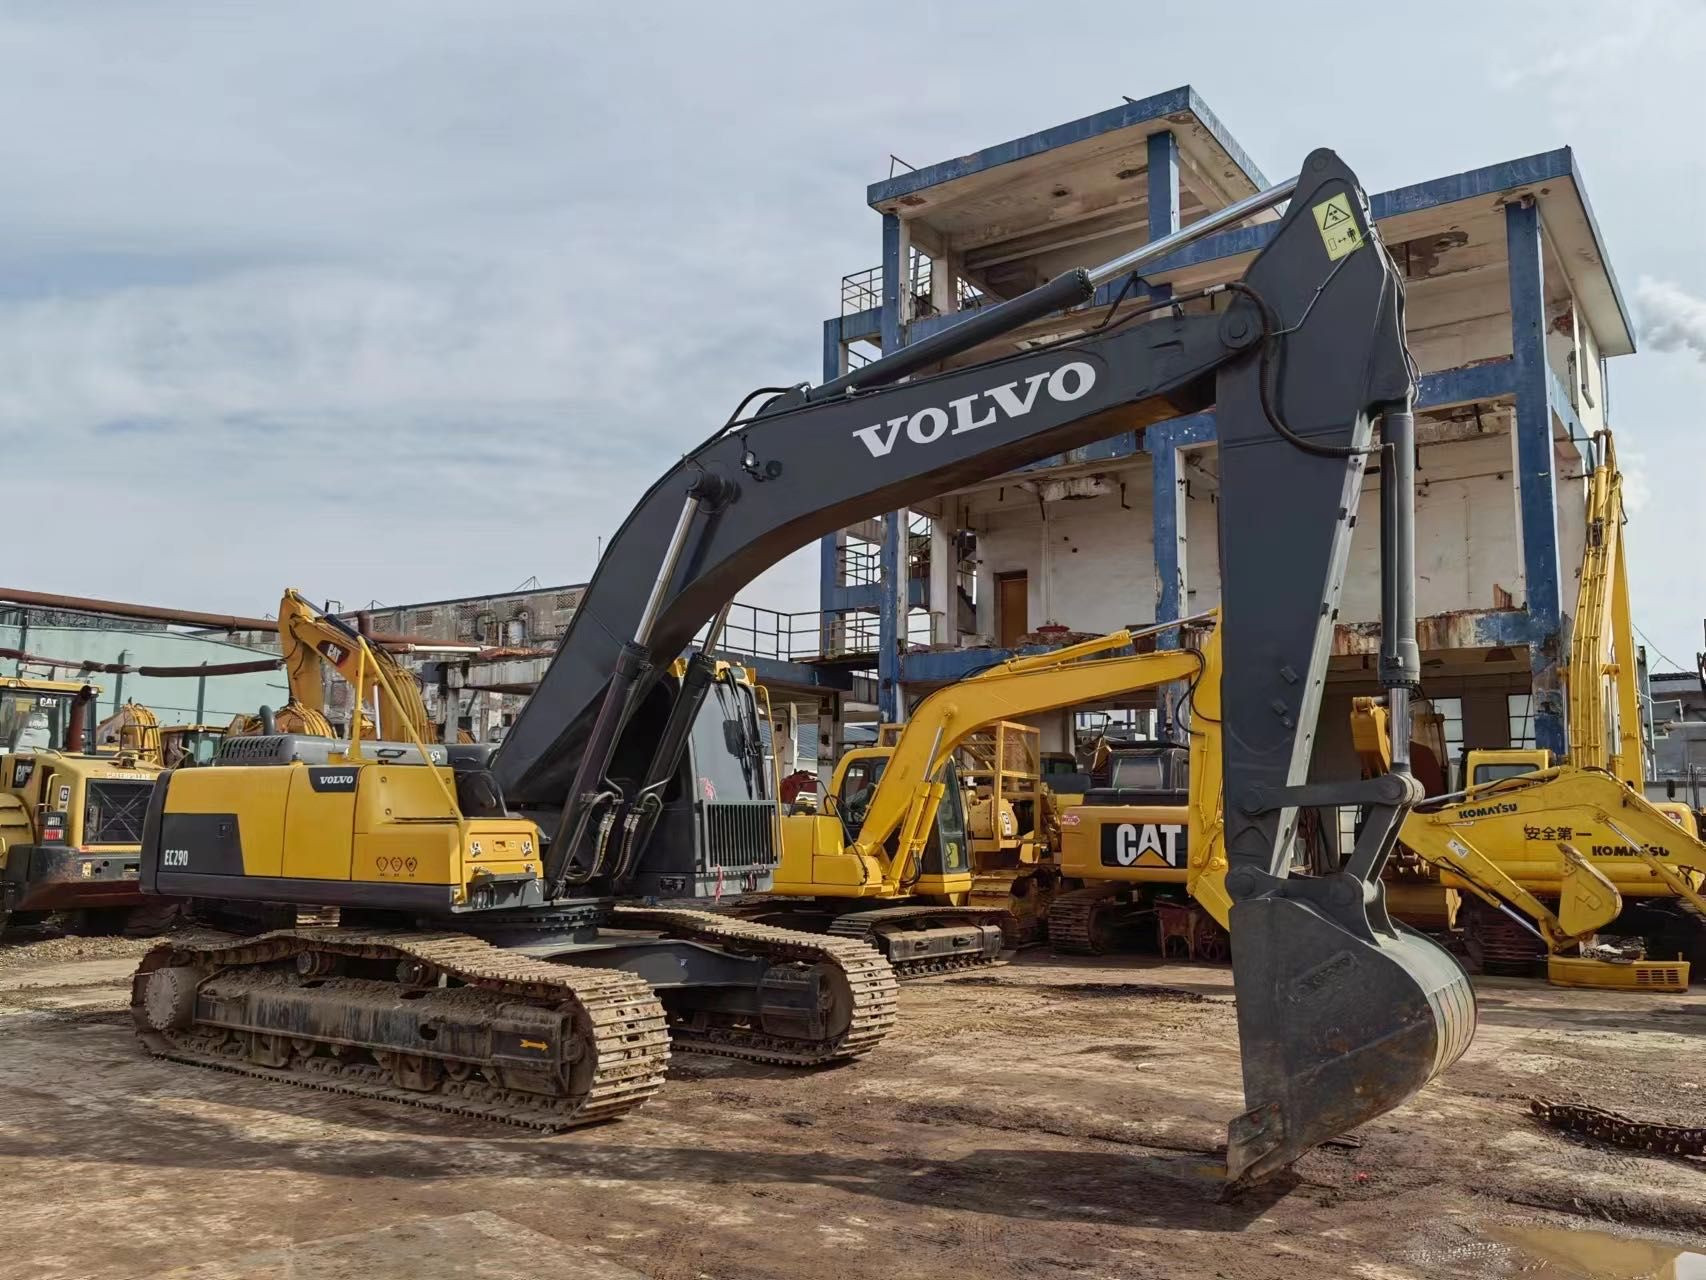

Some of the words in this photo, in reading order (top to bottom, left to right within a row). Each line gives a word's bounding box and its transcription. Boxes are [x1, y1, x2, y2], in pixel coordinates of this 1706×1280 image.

[852, 361, 1096, 458] VOLVO
[327, 643, 341, 663] CAT
[40, 697, 57, 708] CAT
[320, 776, 353, 784] VOLVO
[1459, 803, 1518, 819] KOMATSU
[1524, 826, 1592, 842] 安全第一
[1116, 823, 1182, 867] CAT
[164, 850, 188, 866] EC290
